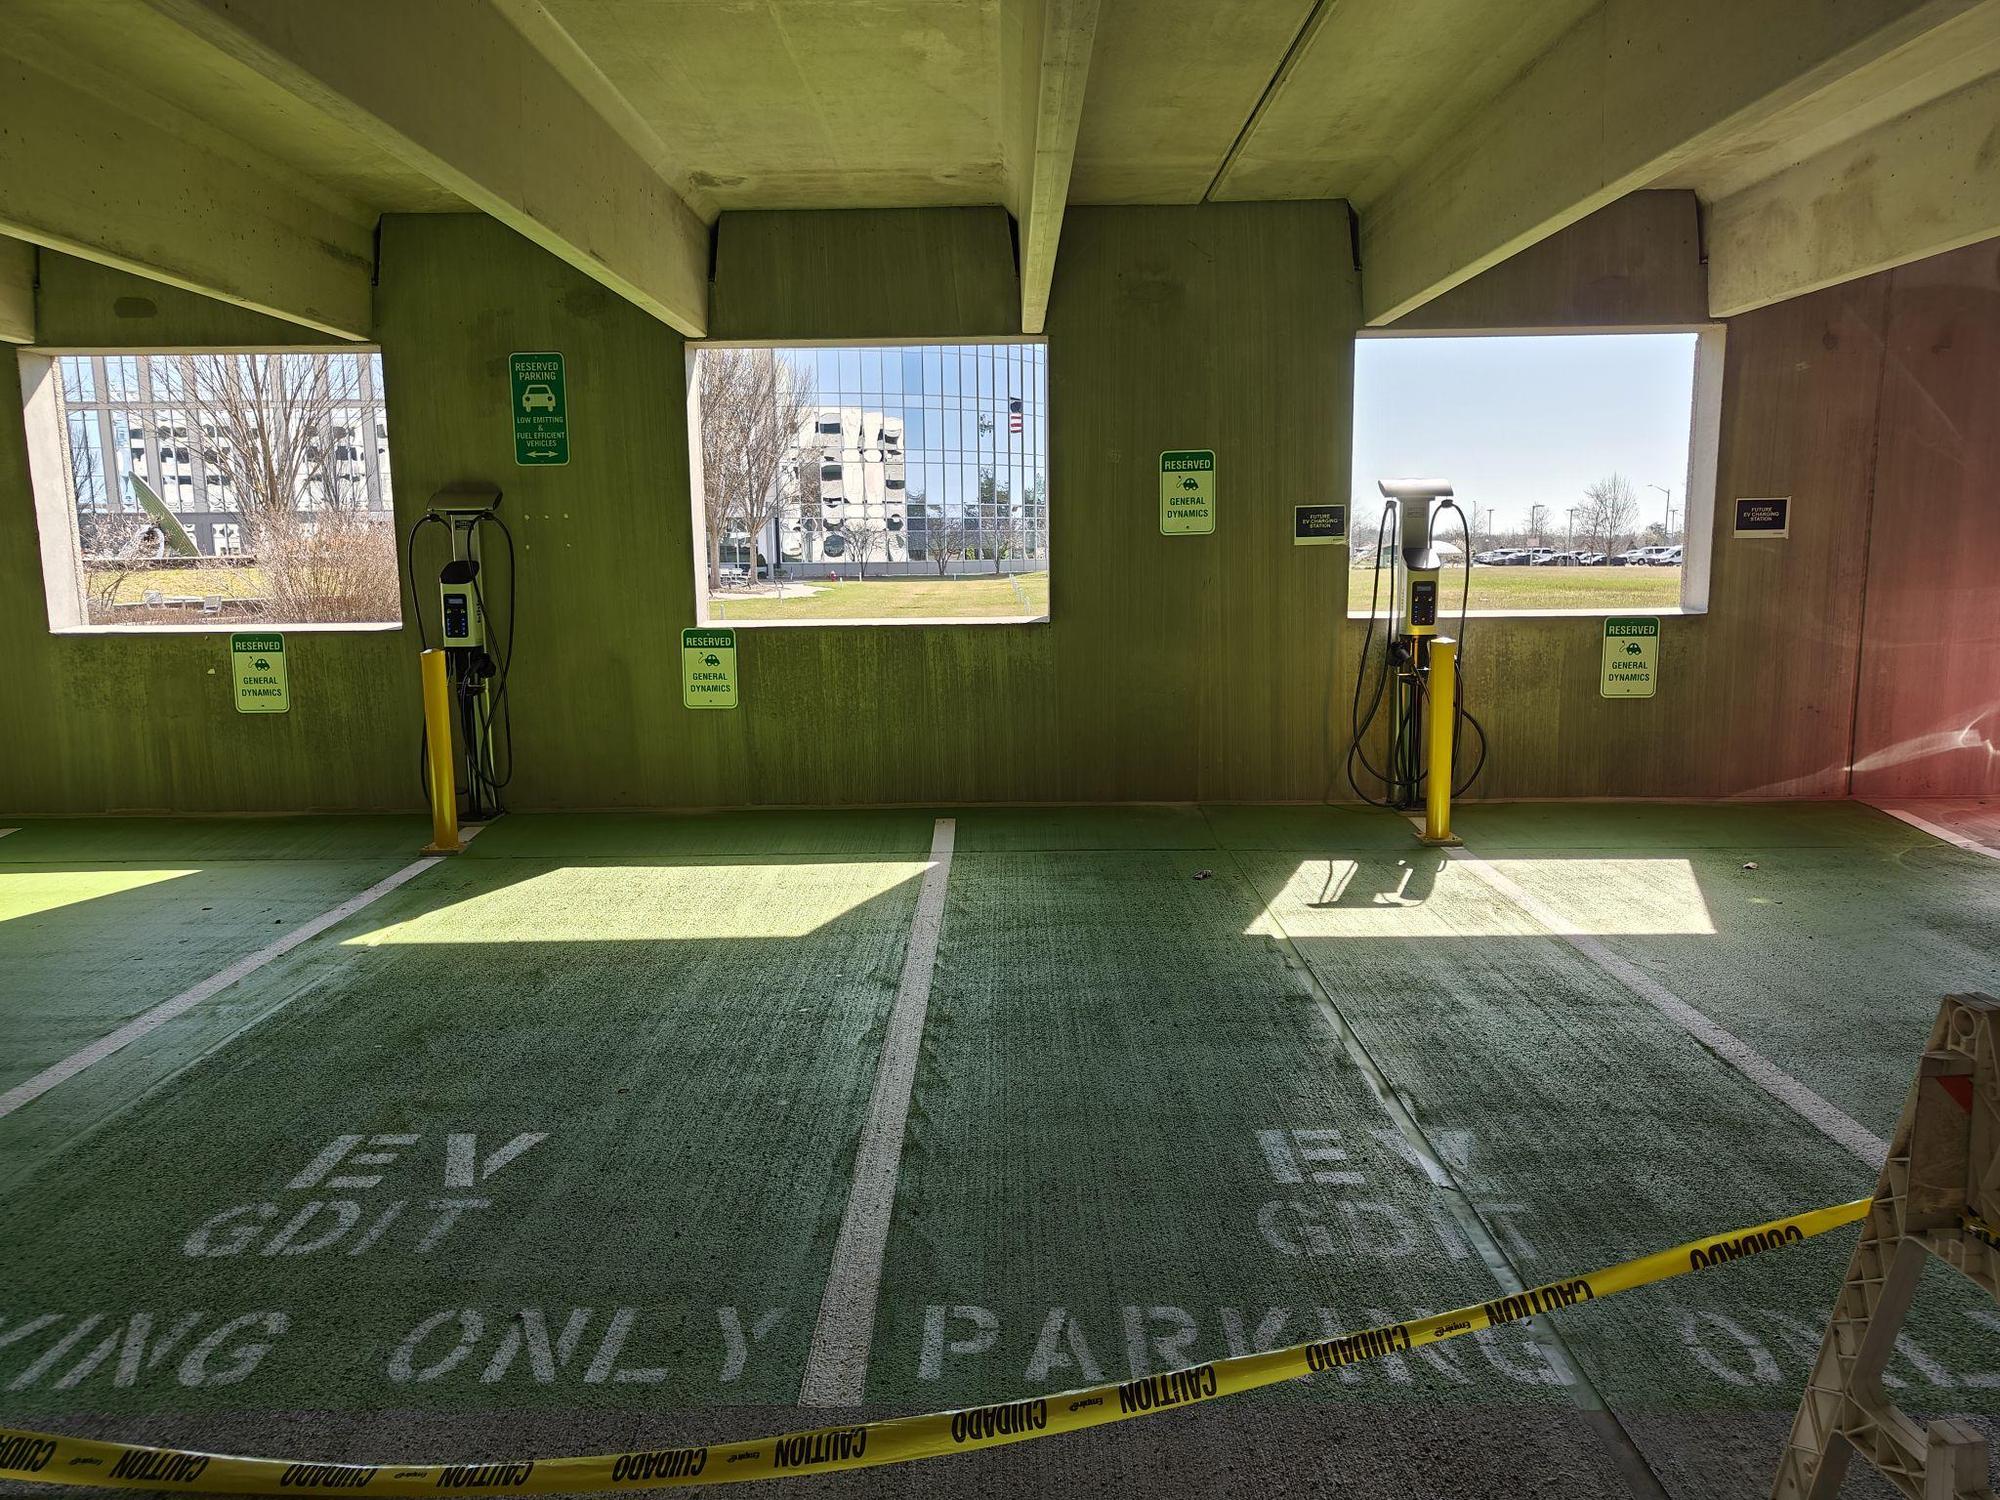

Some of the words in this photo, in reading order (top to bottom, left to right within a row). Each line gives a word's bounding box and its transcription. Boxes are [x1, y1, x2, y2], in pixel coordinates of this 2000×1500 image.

[515, 362, 559, 371] RESERVED
[519, 372, 556, 380] PARKING
[516, 416, 531, 424] LOW
[516, 432, 533, 440] FUEL
[533, 431, 565, 439] EFFICIENT
[1164, 459, 1211, 470] RESERVED
[1169, 497, 1205, 506] GENERAL
[1167, 509, 1209, 518] DYNAMICS
[1609, 625, 1655, 635] RESERVED
[235, 641, 281, 650] RESERVED
[686, 637, 732, 646] RESERVED
[1612, 661, 1648, 670] GENERAL
[243, 677, 278, 685] GENERAL
[692, 672, 728, 681] GENERAL
[1608, 673, 1650, 681] DYNAMICS
[241, 689, 282, 697] DYNAMICS
[690, 685, 731, 693] DYNAMICS
[290, 1132, 550, 1189] EV
[1254, 1128, 1473, 1191] EV
[181, 1200, 492, 1258] GDIT
[1484, 1280, 1595, 1326] CAUTION
[387, 1306, 784, 1384] ONLY
[1305, 1324, 1412, 1372] CUIDADO
[1118, 1364, 1218, 1415] CAUTION
[951, 1399, 1047, 1443] CUIDADO
[774, 1427, 867, 1469] CAUTION
[109, 1450, 210, 1482] CAUTION
[611, 1447, 708, 1482] CUIDADO
[280, 1463, 378, 1488] CUIDADO
[435, 1461, 534, 1488] CAUTION
